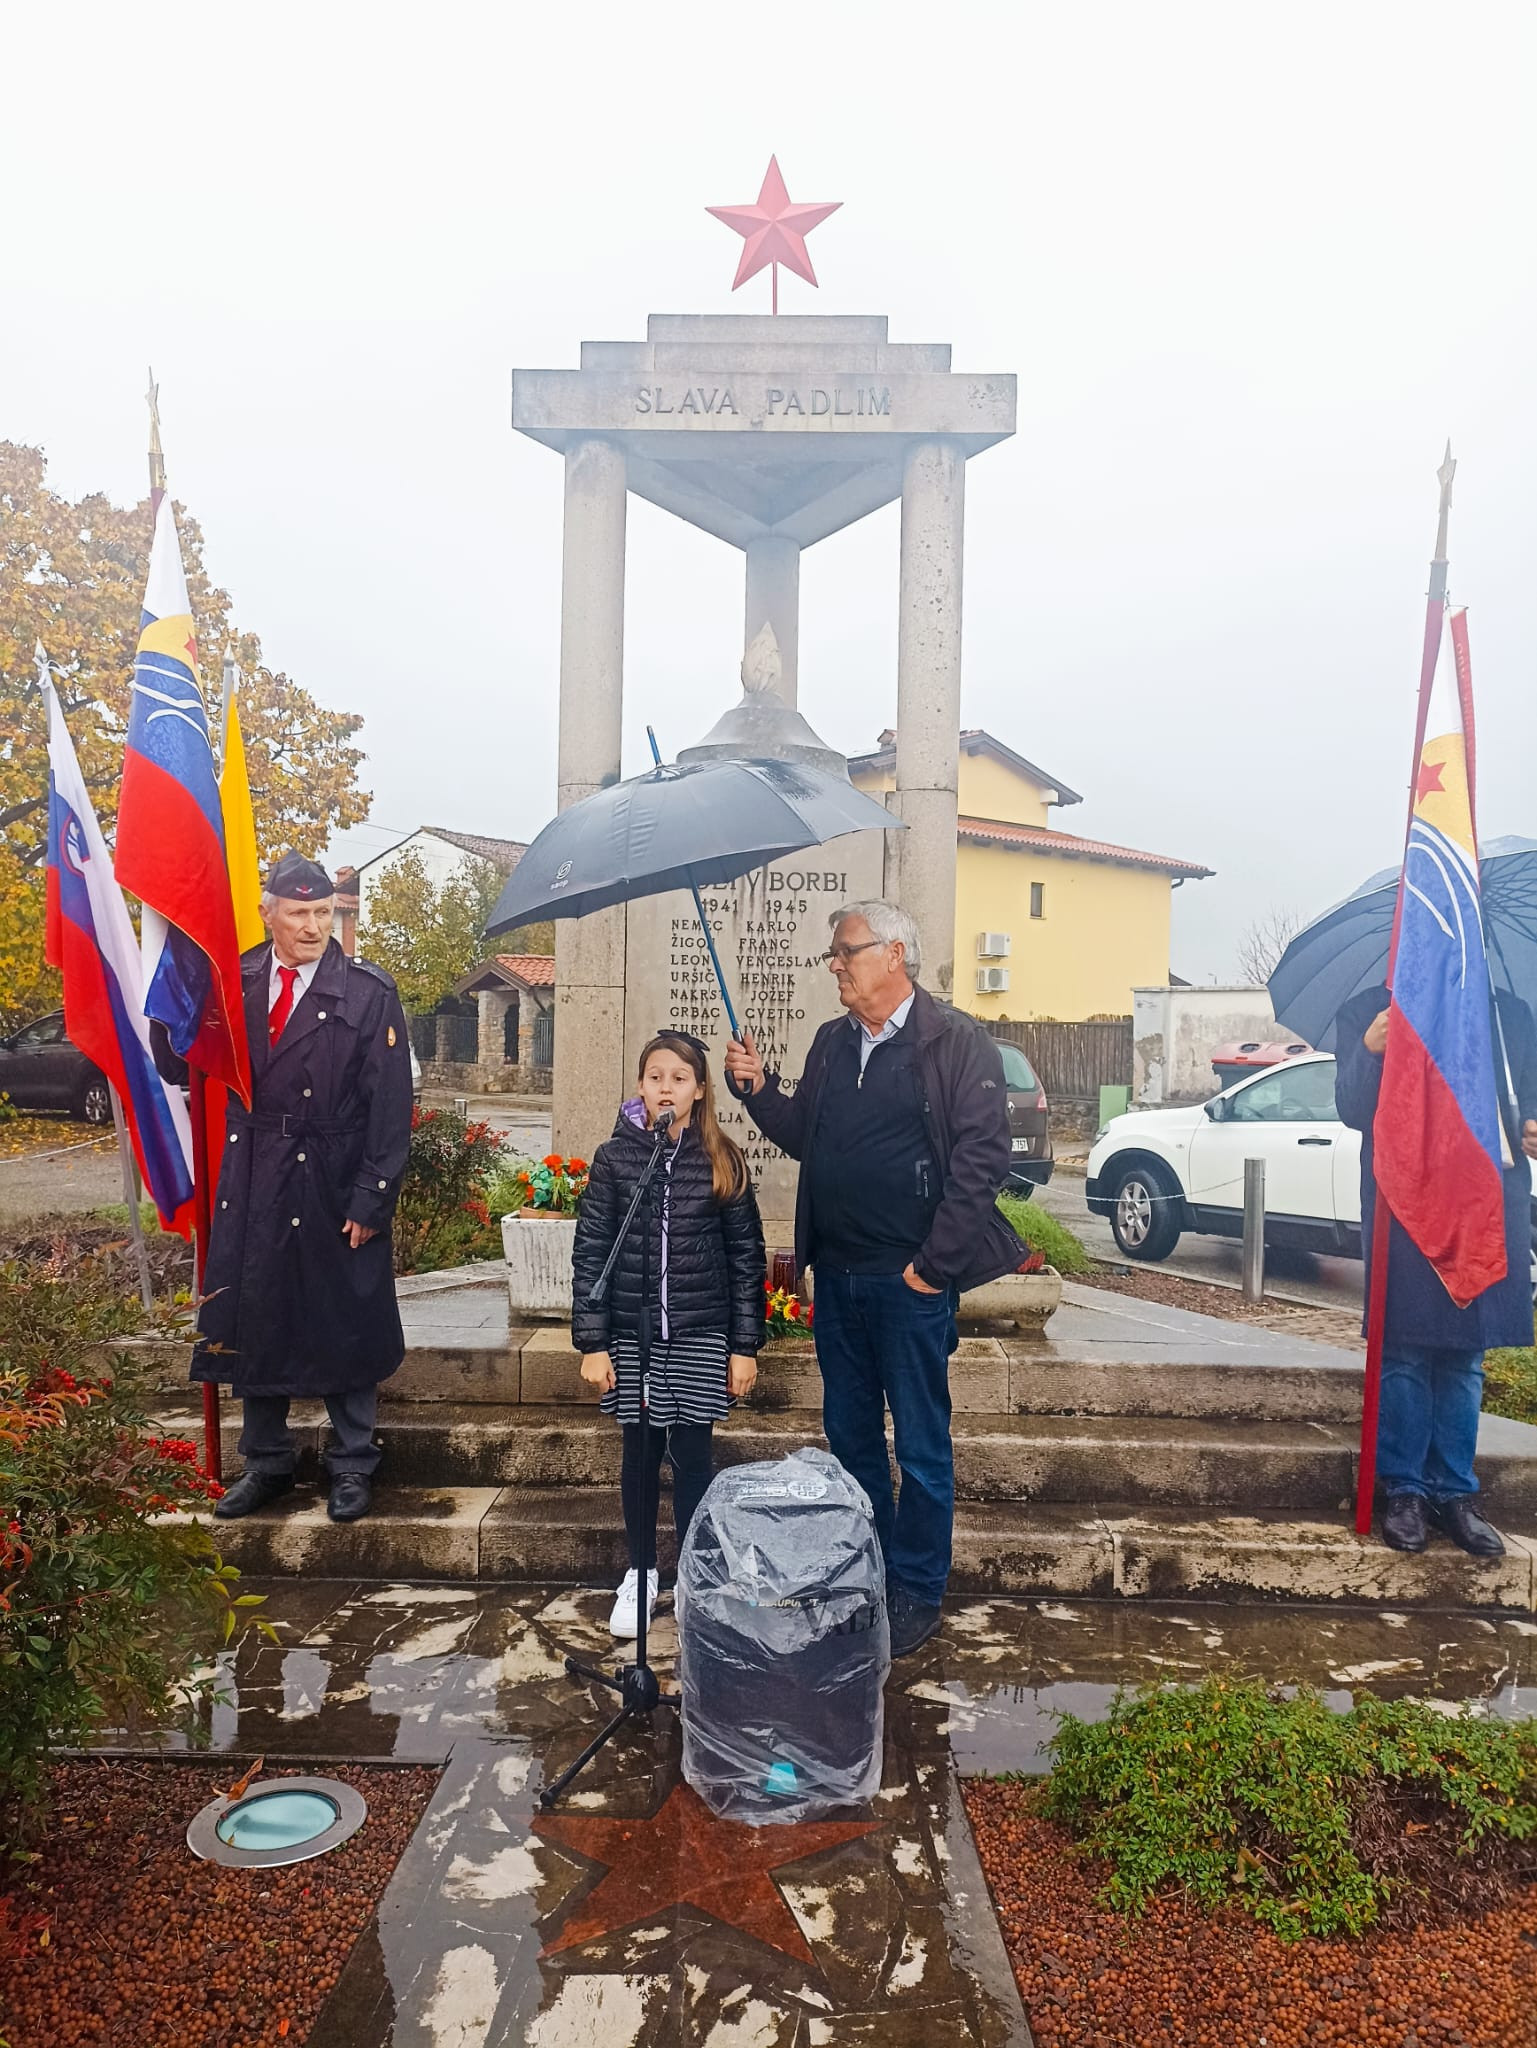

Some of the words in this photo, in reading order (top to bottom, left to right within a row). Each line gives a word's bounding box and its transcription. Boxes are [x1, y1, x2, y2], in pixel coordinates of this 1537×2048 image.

[635, 387, 739, 414] SLAVA
[767, 387, 890, 416] PADLIM
[769, 872, 848, 893] BORBI
[702, 899, 738, 913] 1941
[766, 899, 808, 913] 1945
[671, 919, 723, 931] NEMEC
[746, 921, 797, 933] KARLO
[739, 938, 790, 949] FRANC
[671, 954, 710, 966] LEON
[736, 955, 822, 967] VENCESLAV
[671, 967, 715, 983] URŠIČ
[741, 972, 796, 985] HENRIK
[751, 987, 795, 1001] JOŽEF
[670, 1006, 720, 1018] GRBAC
[745, 1008, 805, 1020] CVETKO
[670, 1023, 718, 1036] TUREL
[744, 1025, 775, 1036] IVAN
[742, 1147, 787, 1159] MARJA
